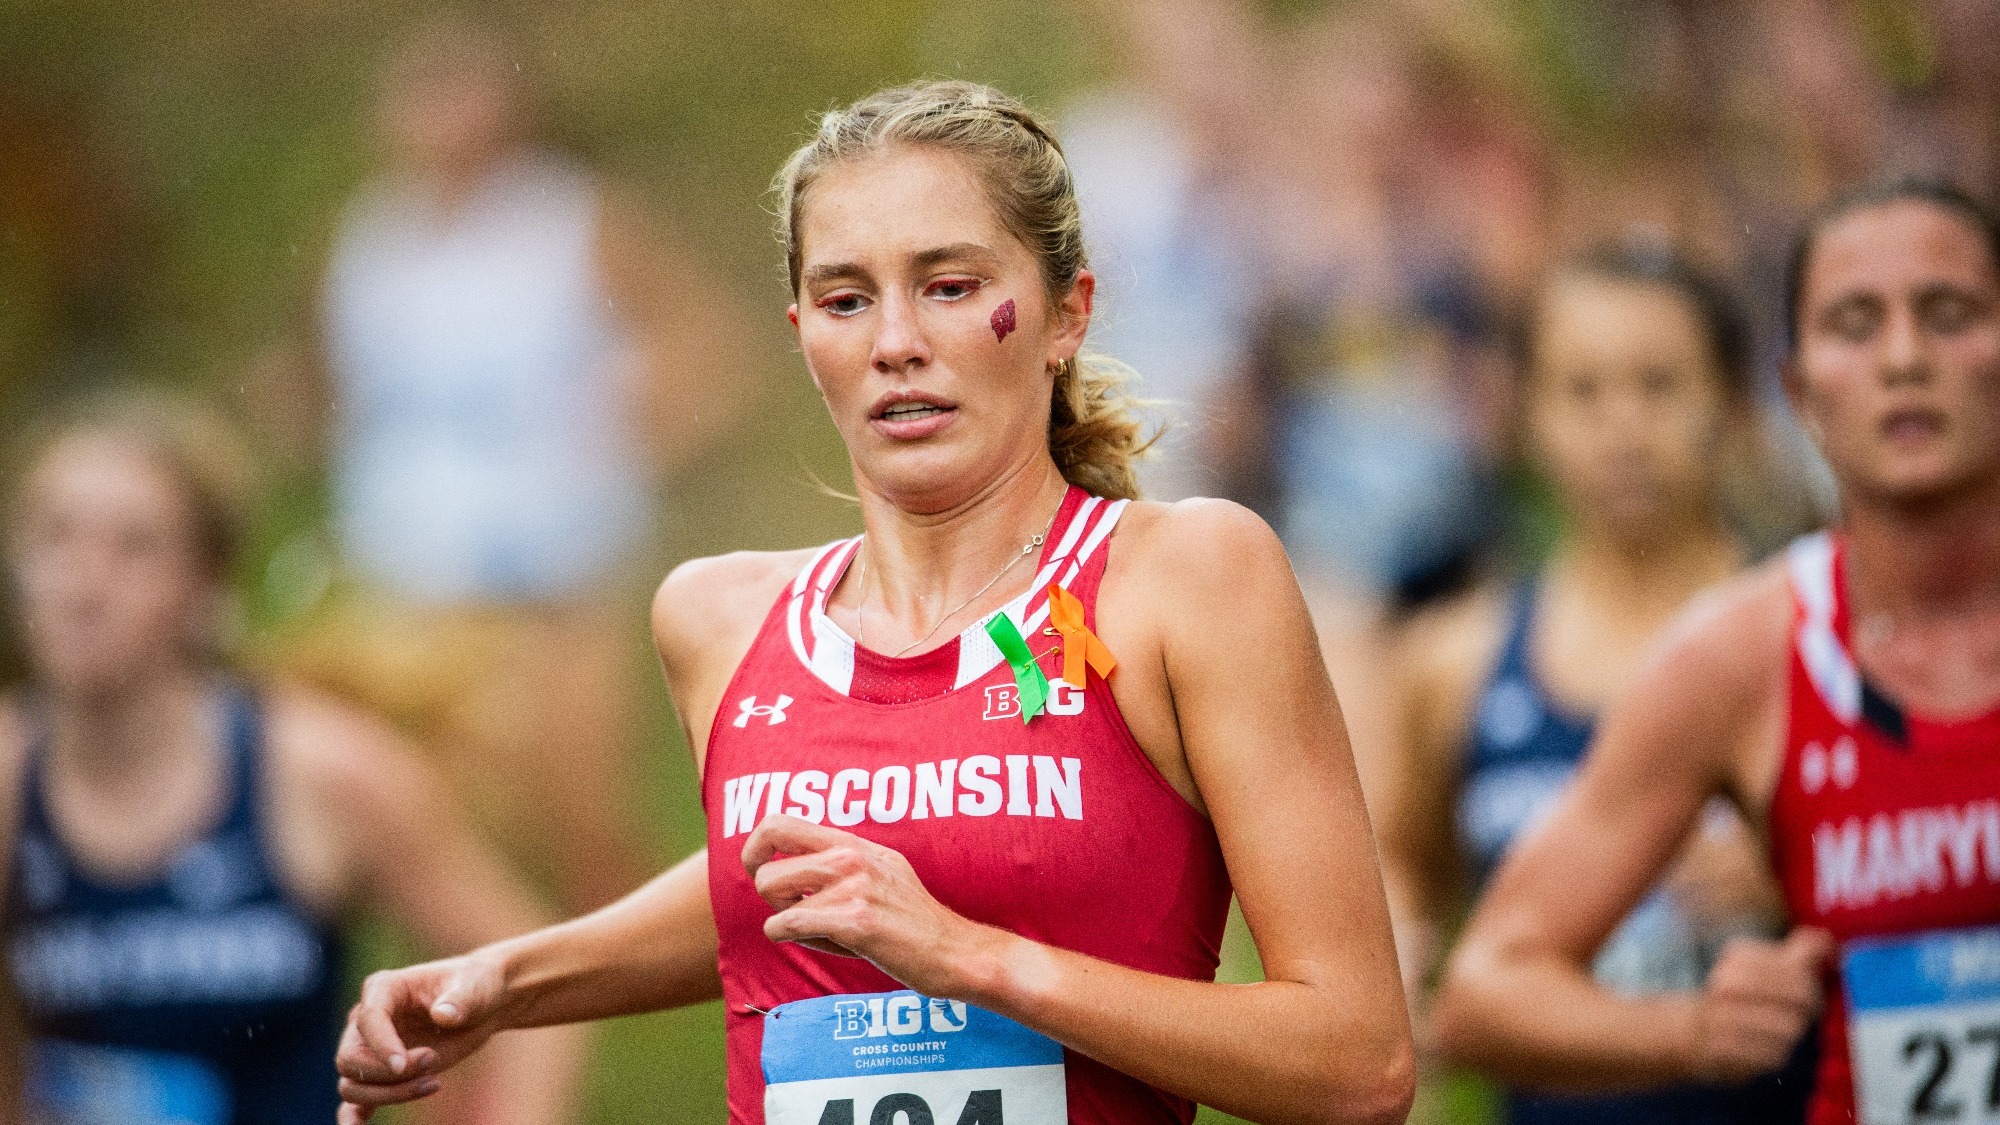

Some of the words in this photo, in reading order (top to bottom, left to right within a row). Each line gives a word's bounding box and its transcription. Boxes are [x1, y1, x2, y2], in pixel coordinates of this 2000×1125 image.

[983, 678, 1085, 720] BG
[723, 755, 1083, 839] WISCONSIN
[834, 996, 922, 1040] BIG
[852, 1044, 889, 1056] CROSS
[891, 1041, 947, 1053] COUNTRY
[855, 1053, 946, 1069] CHAMPIONSHIPS
